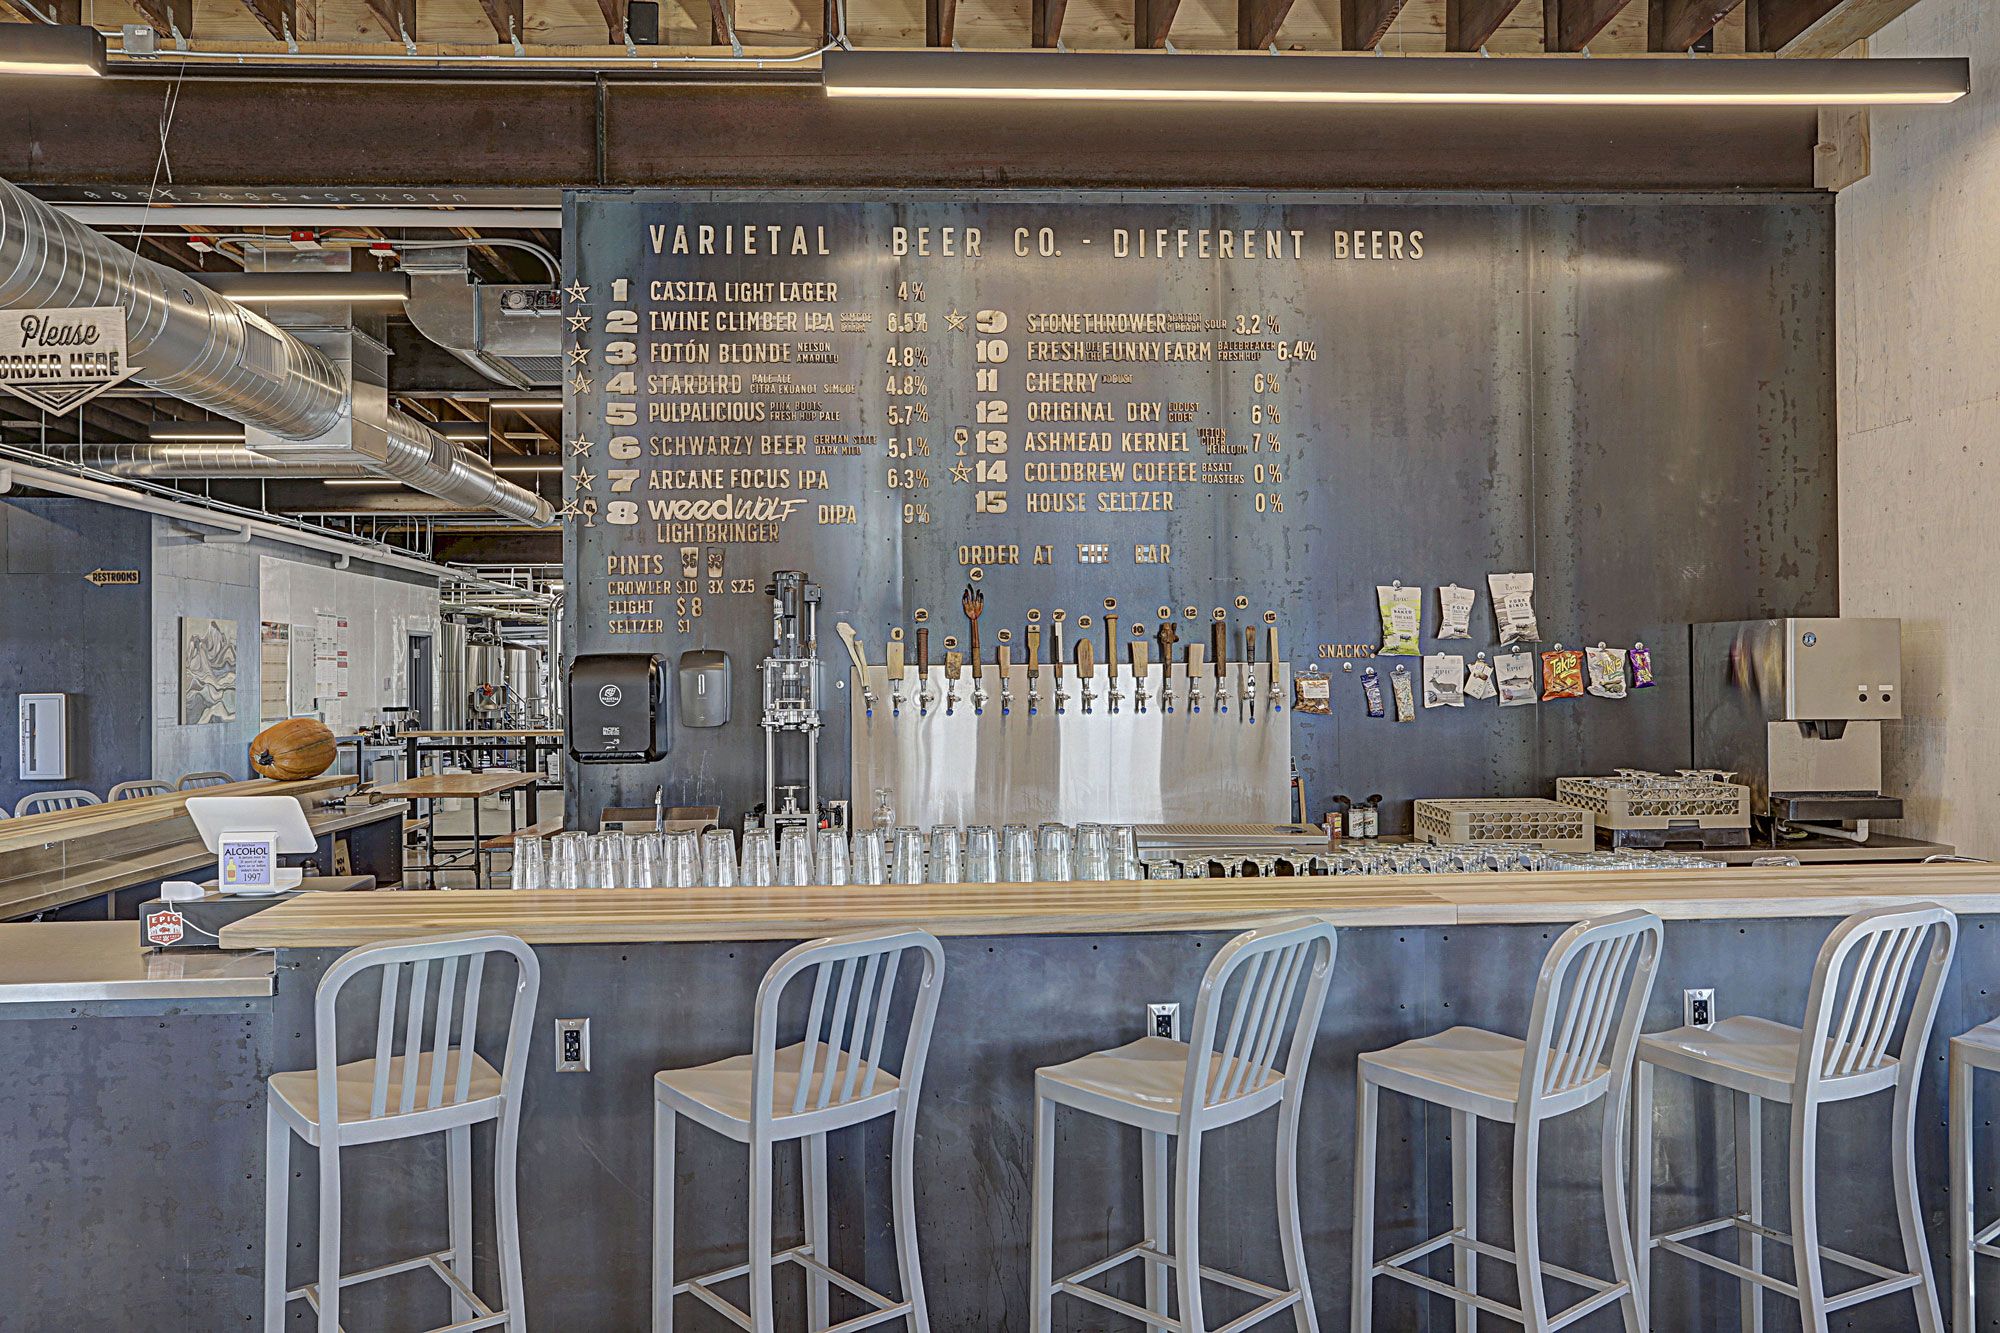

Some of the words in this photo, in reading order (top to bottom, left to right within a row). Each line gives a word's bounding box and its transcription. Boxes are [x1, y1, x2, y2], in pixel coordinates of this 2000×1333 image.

[649, 224, 830, 255] VARIETAL
[892, 227, 981, 256] BEER
[1014, 227, 1061, 257] CO.
[1113, 229, 1304, 258] DIFFERENT
[1334, 231, 1424, 260] BEERS
[611, 279, 628, 302] 1
[651, 281, 717, 302] CASITA
[725, 282, 774, 302] LIGHT
[780, 282, 838, 302] LAGER
[605, 310, 638, 333] 2
[649, 311, 710, 331] TWINE
[716, 312, 797, 331] CLIMBER
[804, 312, 835, 332] IPA
[887, 312, 928, 332] 6.5%
[976, 310, 1008, 333] 9
[1027, 313, 1166, 333] STONETHROWER
[1205, 320, 1227, 329] SOUR
[20, 314, 100, 348] Please
[797, 342, 831, 352] NELSON
[1217, 341, 1276, 351] BALEBREAKER
[605, 341, 638, 365] 3
[650, 339, 710, 363] FOTÓN
[719, 343, 791, 363] BLONDE
[886, 347, 929, 367] 4.8%
[976, 340, 1009, 363] 10
[1027, 341, 1084, 361] FRESH
[1102, 341, 1161, 361] FUNNY
[1163, 342, 1211, 361] FARM
[1277, 341, 1317, 361] 6.4%
[1086, 352, 1101, 361] THE
[1218, 352, 1244, 361] FRESH
[1245, 352, 1261, 361] HOP
[796, 353, 839, 363] AMARILLO
[0, 354, 61, 379] ORDER
[70, 352, 120, 377] HERE
[605, 371, 637, 395] 4
[648, 375, 742, 394] STARBIRD
[886, 375, 928, 395] 4.8%
[752, 374, 774, 383] PALE
[777, 374, 792, 383] ALE
[976, 369, 998, 392] 11
[1026, 373, 1099, 392] CHERRY
[750, 384, 776, 394] CITRA
[779, 384, 817, 394] EKUANOT
[823, 384, 856, 394] SIMCOE
[770, 402, 791, 411] PINK
[795, 402, 823, 411] BOOTS
[976, 400, 1008, 423] 12
[1027, 402, 1115, 422] ORIGINAL
[1127, 402, 1162, 422] DRY
[1168, 402, 1200, 412] LOCUST
[605, 402, 638, 426] 5
[649, 402, 765, 422] PULPALICIOUS
[888, 402, 929, 425] 5.7%
[770, 411, 797, 421] FRESH
[800, 411, 817, 421] HOP
[819, 411, 840, 421] PALE
[1168, 412, 1194, 422] CIDER
[813, 434, 849, 445] GERMAN
[852, 435, 878, 445] STYLE
[976, 430, 1008, 453] 13
[1025, 432, 1112, 452] ASHMEAD
[1122, 432, 1190, 452] KERNEL
[1202, 437, 1226, 446] CIDER
[608, 436, 642, 459] 6
[650, 436, 753, 456] SCHWARZY
[761, 435, 807, 455] BEER
[888, 437, 930, 459] 5.1%
[815, 446, 838, 455] DARK
[841, 446, 862, 455] MILD
[1207, 445, 1248, 455] HEIRLOOM
[976, 460, 1008, 483] 14
[1025, 462, 1126, 482] COLDBREW
[1132, 462, 1198, 482] COFFEE
[1202, 462, 1232, 472] BASALT
[608, 469, 640, 492] 7
[649, 469, 724, 490] ARCANE
[731, 469, 790, 489] FOCUS
[798, 470, 829, 490] IPA
[887, 468, 930, 489] 6.3%
[1202, 474, 1245, 484] ROASTERS
[975, 491, 1008, 513] 15
[1027, 493, 1087, 513] HOUSE
[1098, 491, 1174, 512] SELTZER
[606, 501, 639, 525] 8
[819, 505, 857, 524] DIPA
[904, 504, 930, 524] 9%
[657, 523, 780, 543] LIGHTBRINGER
[959, 545, 1020, 565] ORDER
[1033, 545, 1054, 565] AT
[1076, 544, 1110, 564] THE
[1135, 544, 1171, 564] BAR
[608, 555, 663, 576] PINTS
[682, 553, 697, 569] $5
[92, 572, 138, 582] RESTROOMS
[608, 580, 671, 595] CROWLER
[676, 580, 698, 595] $10
[708, 580, 724, 594] 3X
[731, 579, 755, 594] $25
[608, 600, 654, 615] FLIGHT
[1236, 598, 1247, 607] 14
[916, 611, 927, 619] 2
[1054, 611, 1065, 620] 7
[1160, 609, 1168, 617] 11
[1185, 609, 1196, 617] 12
[1214, 609, 1225, 618] 13
[1265, 613, 1276, 621] 15
[608, 619, 663, 634] SELTZER
[678, 619, 691, 634] $1
[1133, 625, 1144, 634] 10
[894, 630, 901, 638] 1
[1319, 644, 1376, 659] SNACKS:
[224, 847, 268, 856] ALCOHOL
[244, 873, 261, 882] 1997
[151, 916, 179, 924] EPIC
